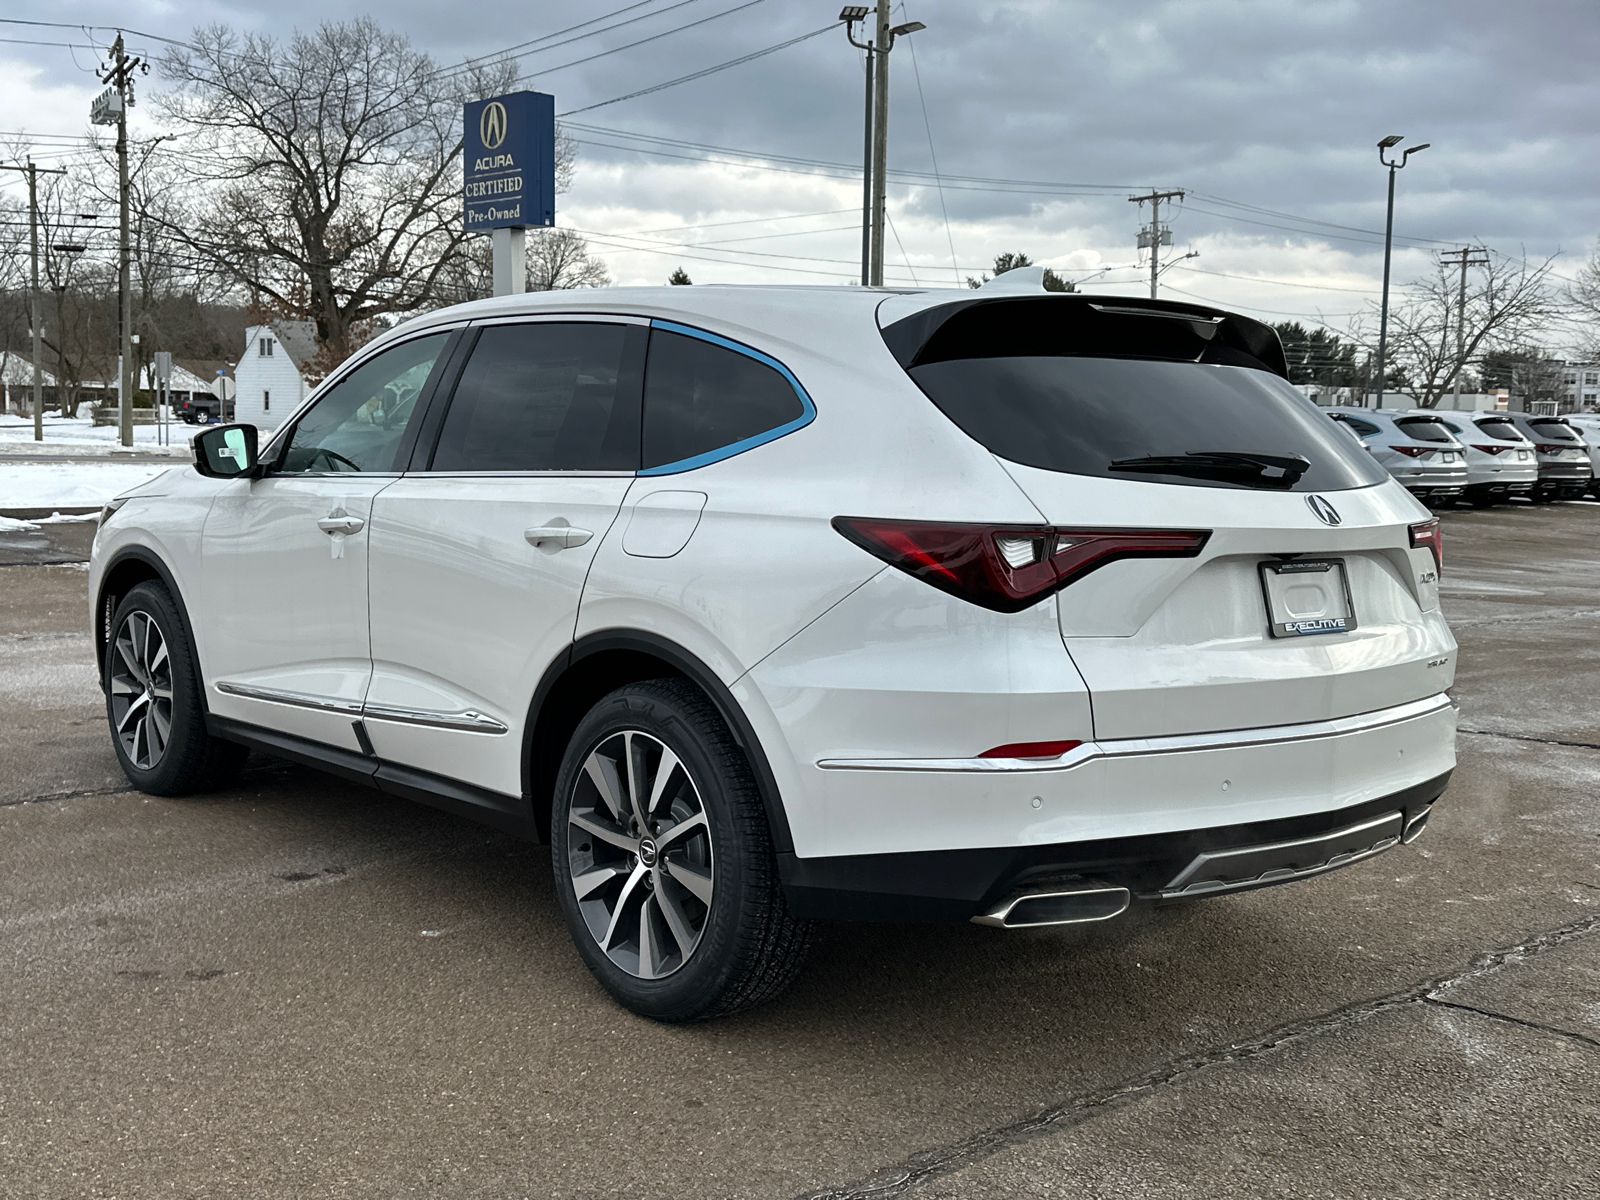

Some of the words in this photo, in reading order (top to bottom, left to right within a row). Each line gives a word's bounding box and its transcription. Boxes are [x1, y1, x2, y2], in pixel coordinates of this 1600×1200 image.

[474, 154, 514, 171] ACURA
[465, 176, 523, 197] CERTIFIED
[468, 204, 520, 223] Pre-Owned
[1285, 618, 1346, 632] EXECUTIVE
